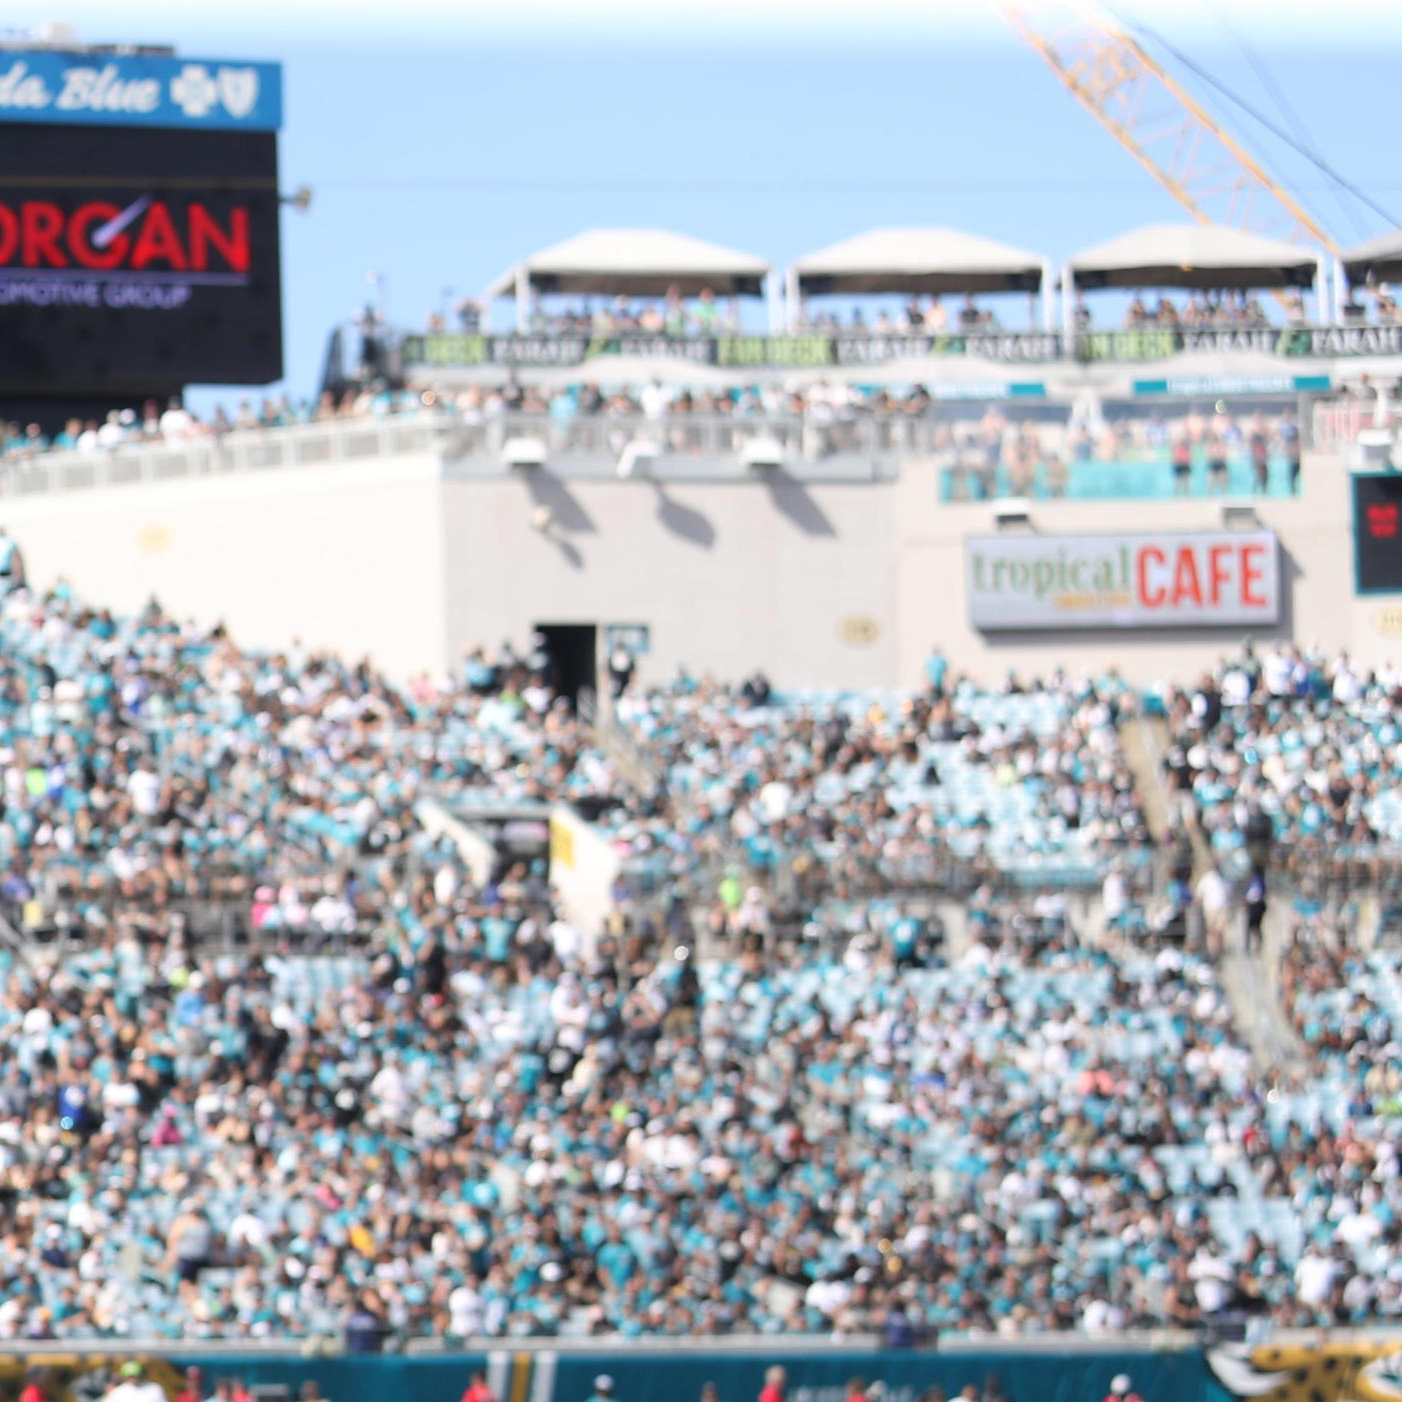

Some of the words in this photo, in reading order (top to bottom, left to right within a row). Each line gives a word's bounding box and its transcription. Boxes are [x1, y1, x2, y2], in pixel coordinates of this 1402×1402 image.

[56, 62, 160, 113] Blue
[102, 284, 192, 309] GROUP
[972, 543, 1131, 602] tropical
[1137, 543, 1269, 609] CAFE
